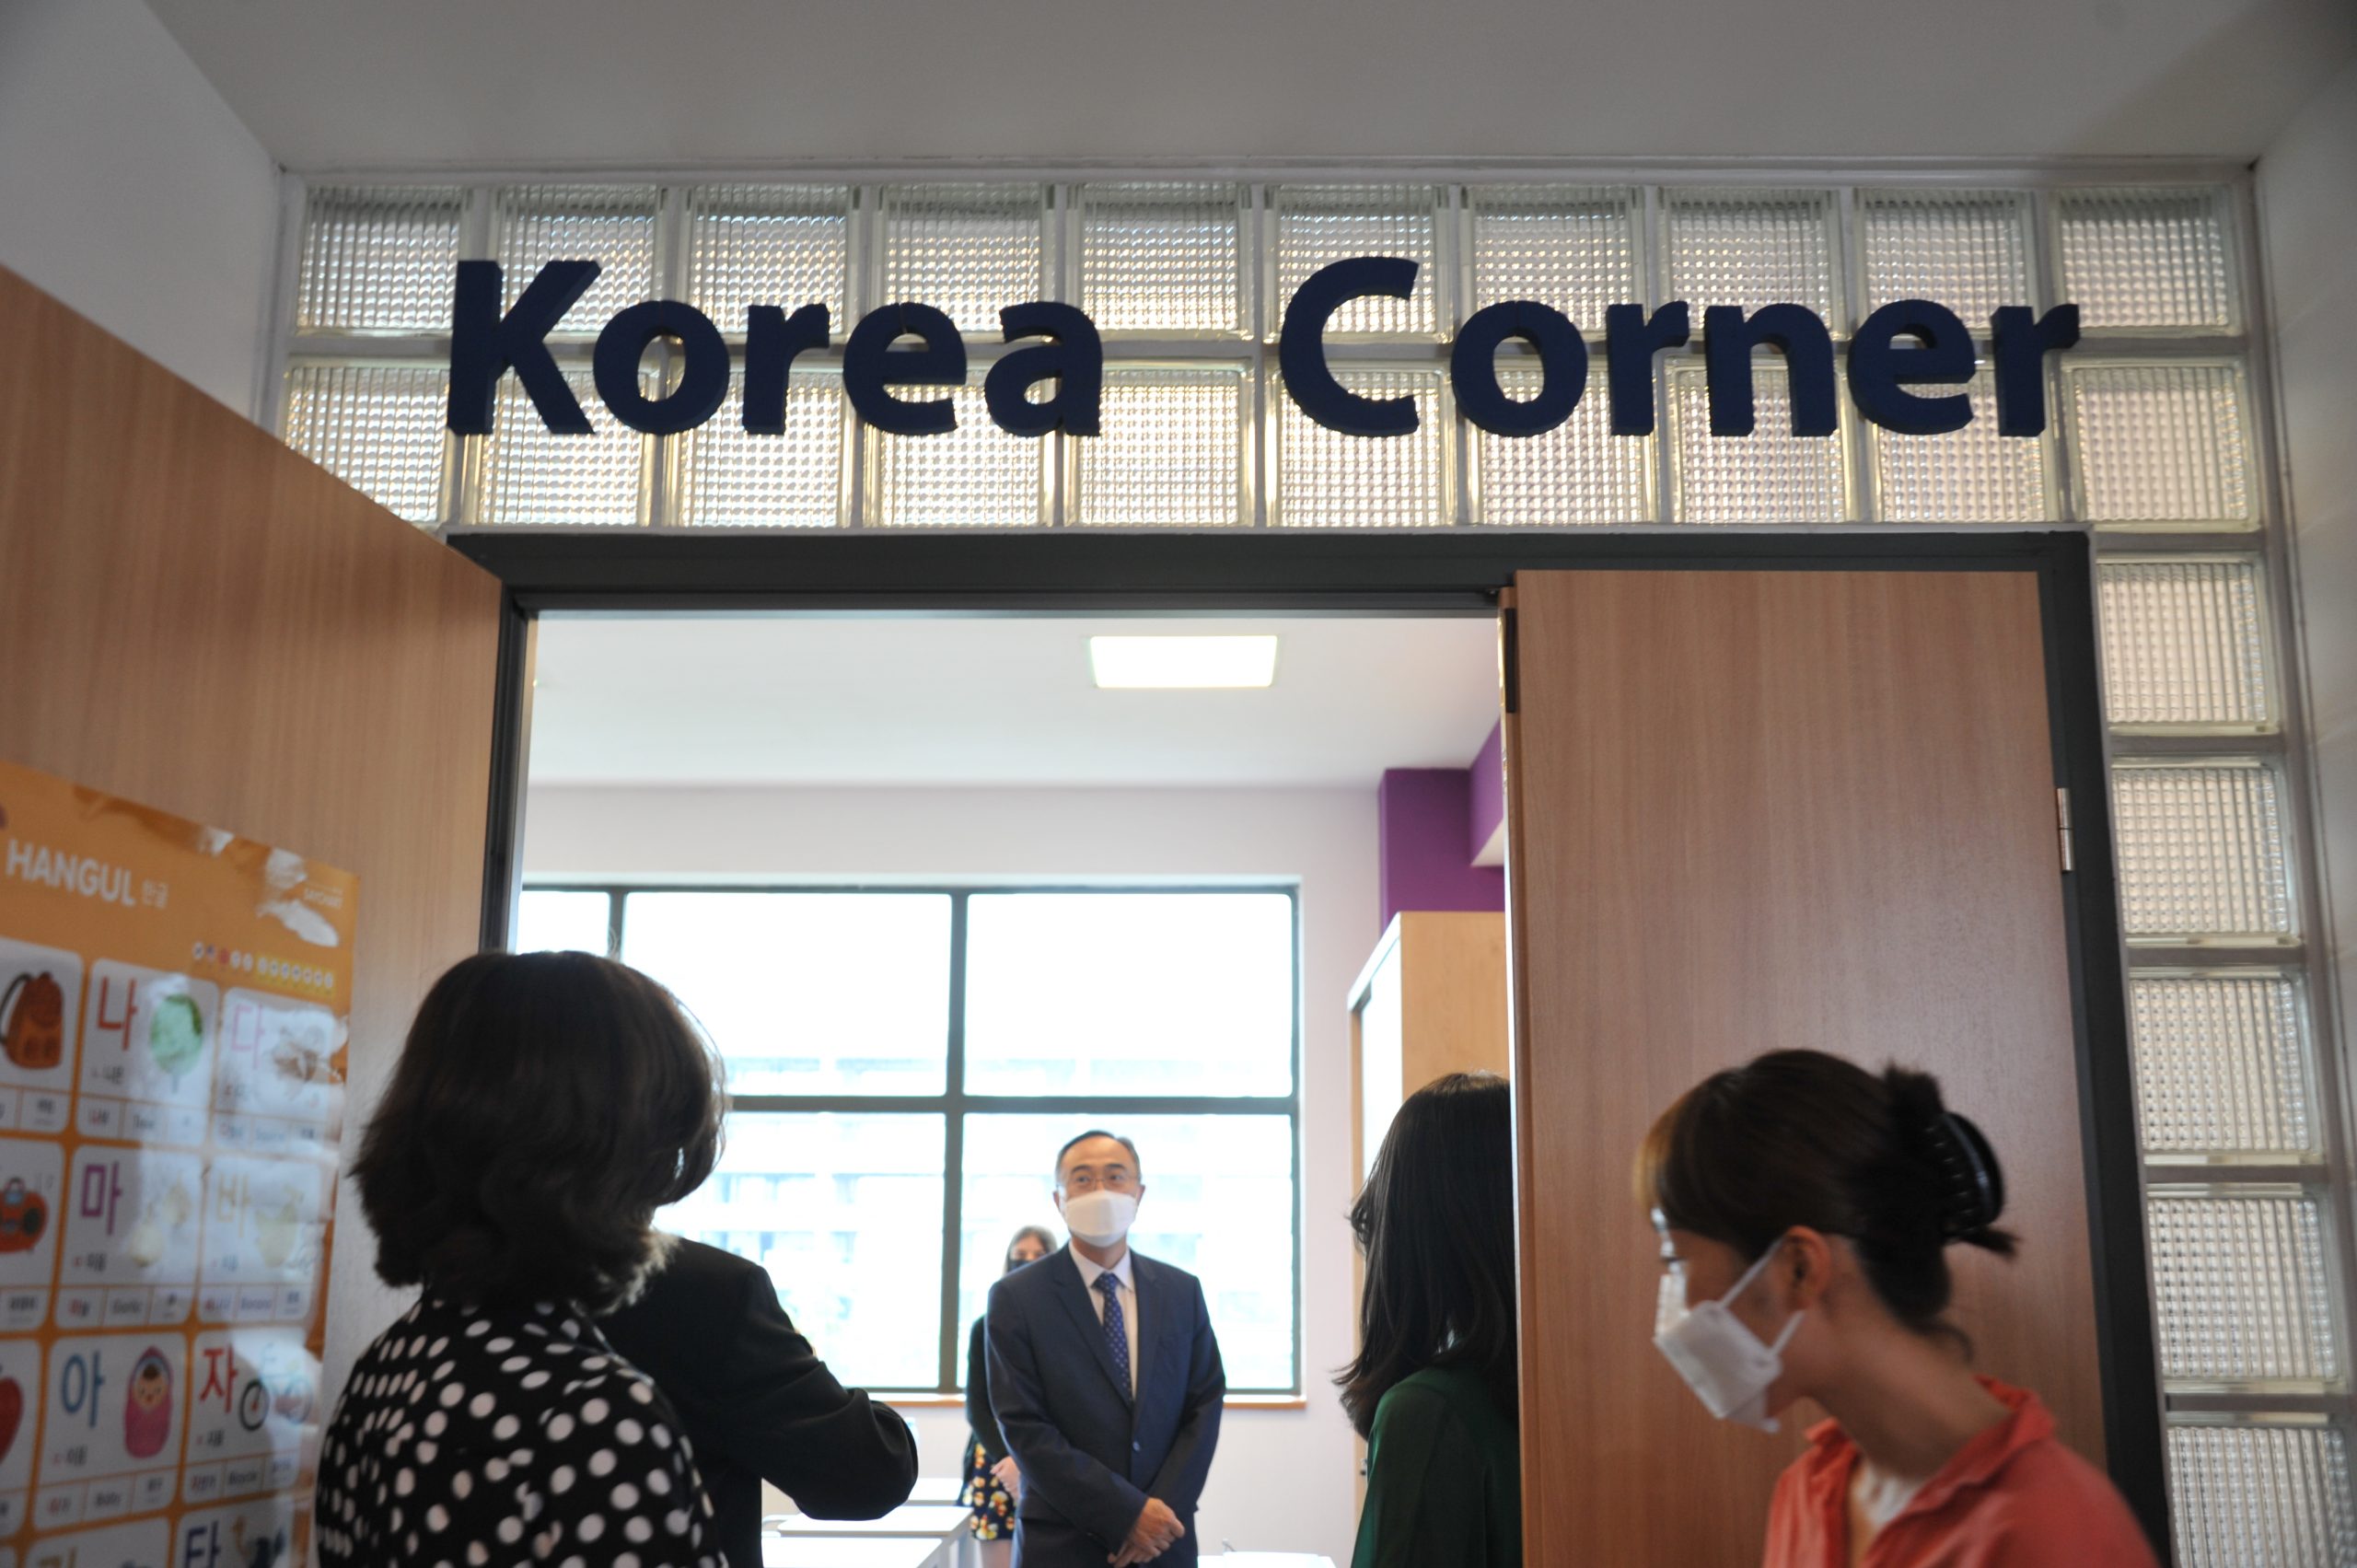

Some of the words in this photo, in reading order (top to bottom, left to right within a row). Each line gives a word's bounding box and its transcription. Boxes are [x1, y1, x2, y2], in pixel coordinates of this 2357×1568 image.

[447, 259, 1104, 436] Korea
[1279, 256, 2080, 437] Corner
[6, 838, 136, 908] HANGUL
[98, 975, 138, 1051] 나
[81, 1161, 122, 1236] 마
[61, 1350, 105, 1429] 아
[199, 1343, 238, 1414] 자
